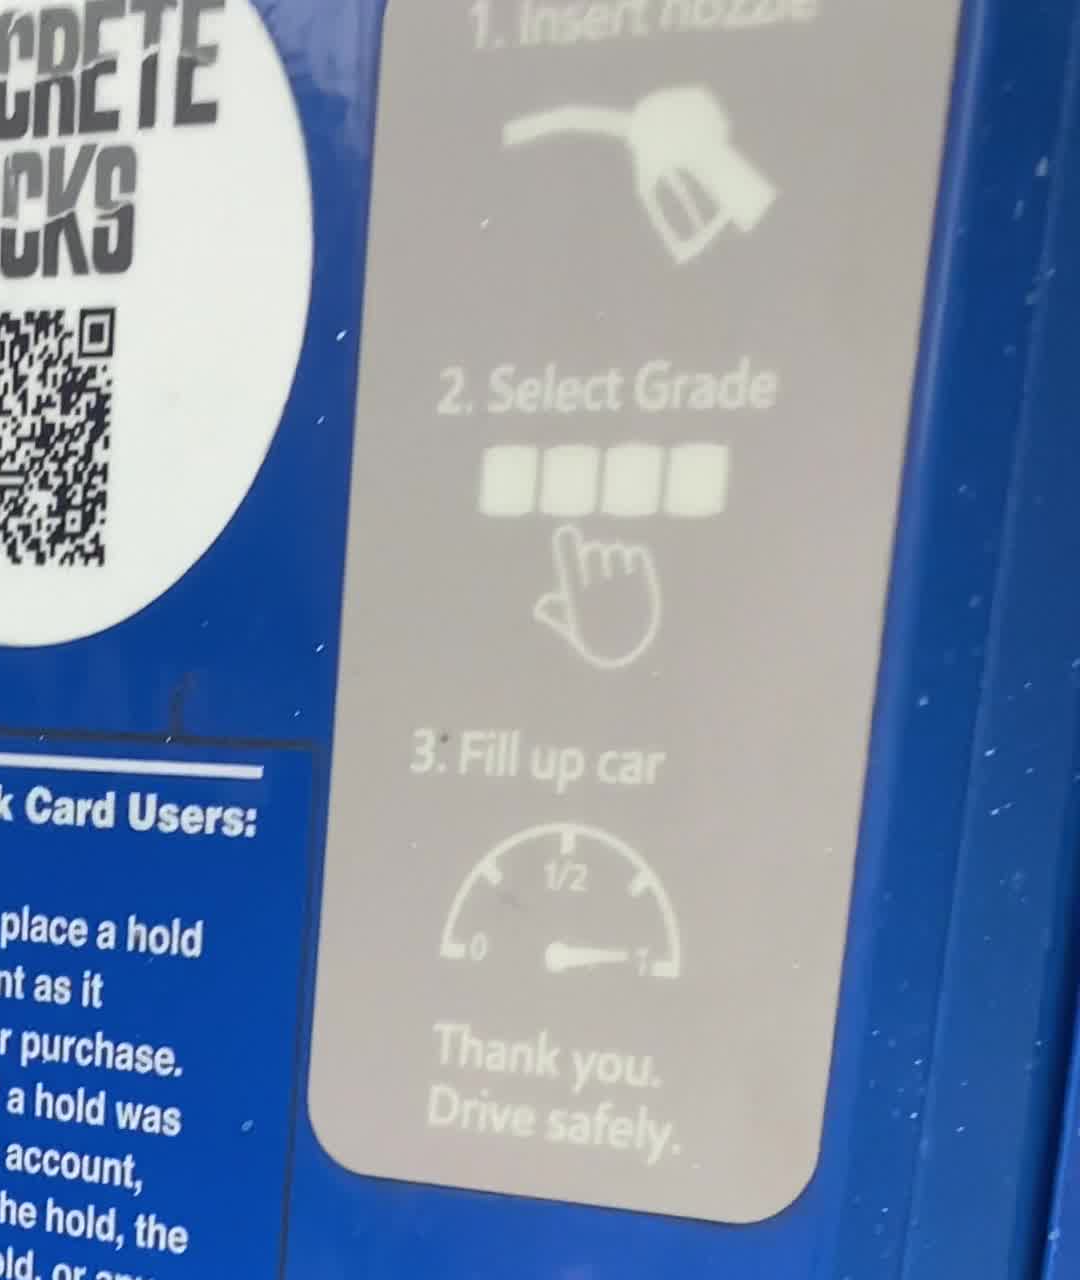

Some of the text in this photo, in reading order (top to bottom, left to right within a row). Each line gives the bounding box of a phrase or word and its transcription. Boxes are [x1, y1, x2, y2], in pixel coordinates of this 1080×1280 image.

[436, 356, 780, 416] 2. Select Grade
[409, 727, 667, 793] 3. Fill up car
[25, 786, 115, 829] Card
[128, 793, 258, 839] Users:
[0, 905, 88, 951] place
[96, 922, 117, 951] a
[126, 915, 204, 960] hold
[33, 975, 72, 1007] as
[81, 969, 104, 1009] it
[21, 1028, 185, 1078] purchase.
[434, 1022, 662, 1094] Thank you.
[7, 1086, 26, 1114] a
[34, 1082, 106, 1126] hold
[116, 1103, 182, 1137] was
[428, 1084, 682, 1167] Drive safely.
[6, 1143, 144, 1196] account,
[45, 1198, 126, 1252] hold,
[134, 1214, 189, 1256] the
